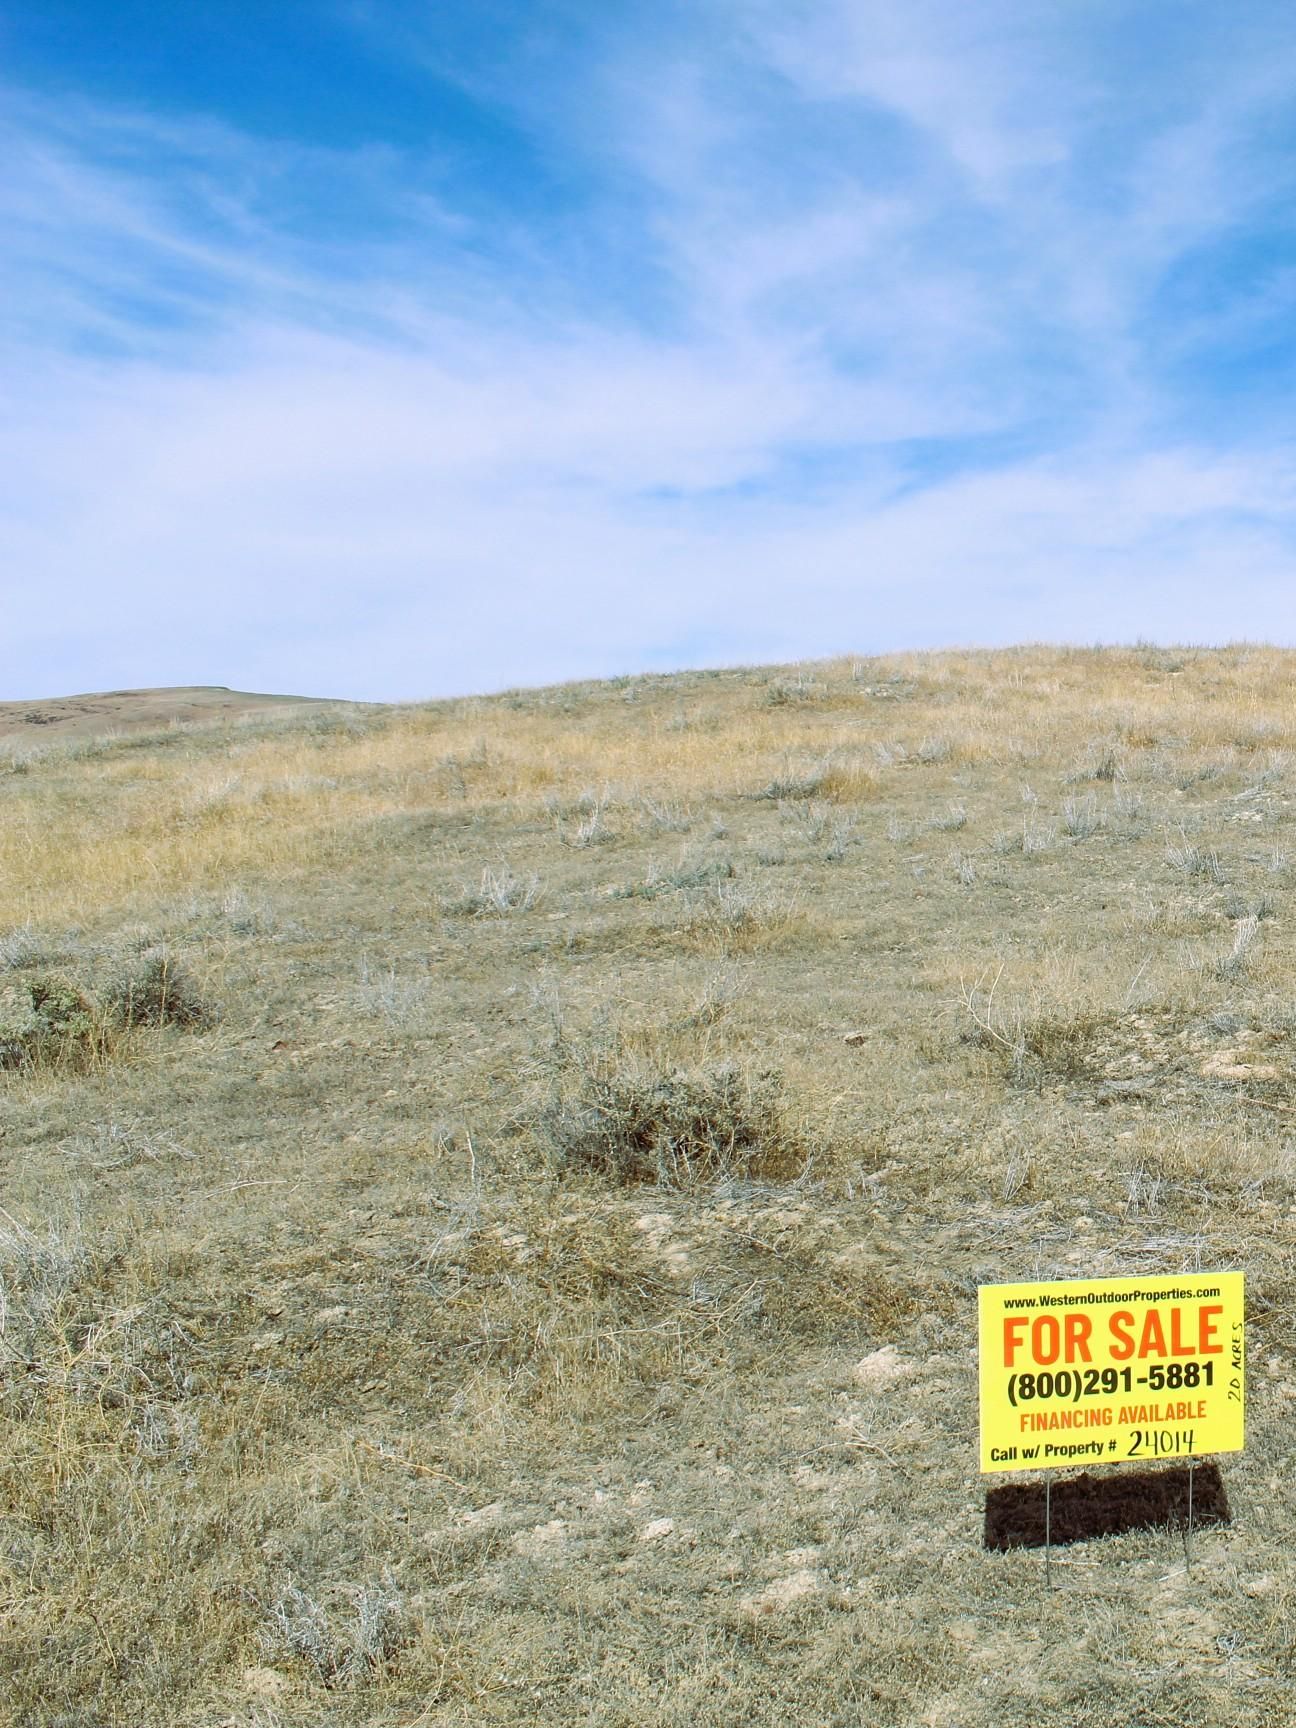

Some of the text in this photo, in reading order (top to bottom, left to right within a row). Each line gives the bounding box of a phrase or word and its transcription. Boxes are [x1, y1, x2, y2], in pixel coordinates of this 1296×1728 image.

[1004, 1288, 1220, 1308] www.WesternOutdoorProperties.com
[1003, 1305, 1223, 1367] FOR SALE
[1231, 1322, 1243, 1371] ACRES
[1007, 1361, 1214, 1406] (800)291-5881
[1020, 1400, 1207, 1432] FINANCING AVAILABLE
[991, 1429, 1197, 1461] Call w/ Property # 24014
